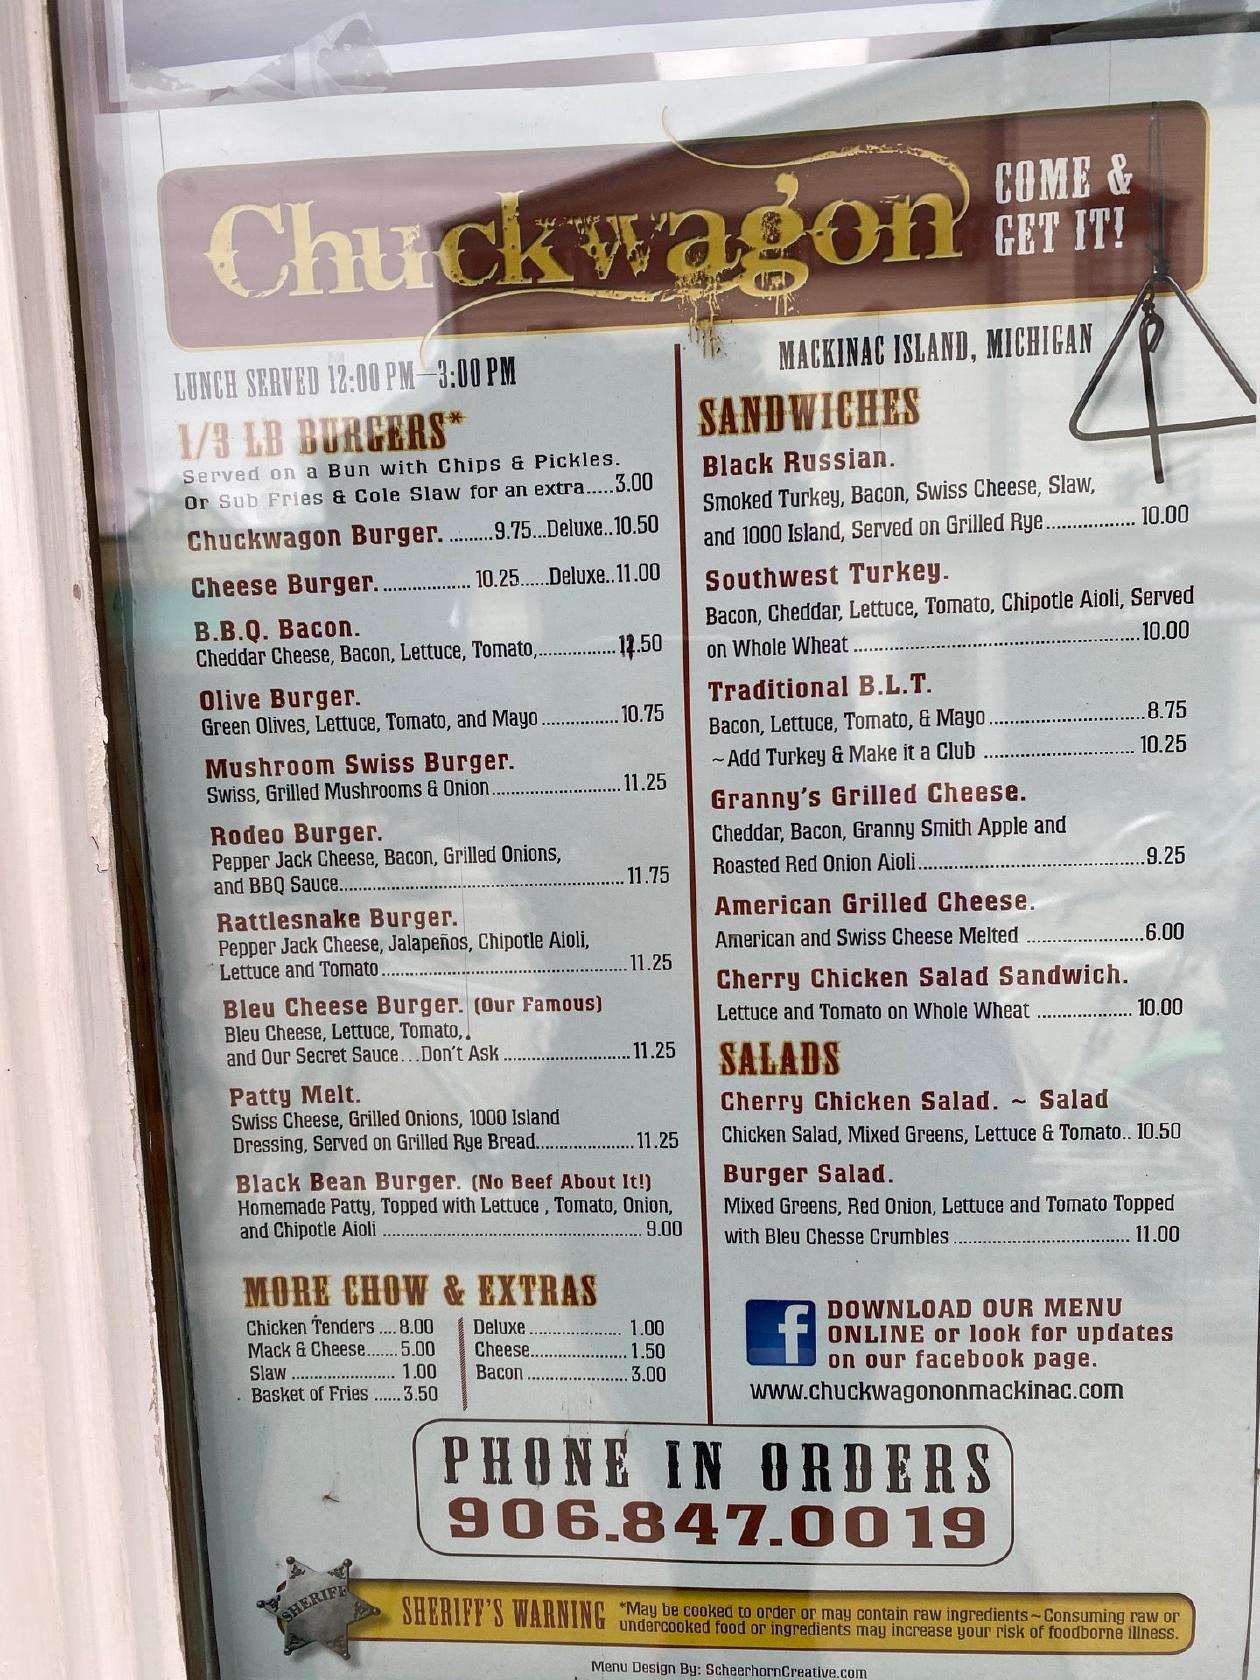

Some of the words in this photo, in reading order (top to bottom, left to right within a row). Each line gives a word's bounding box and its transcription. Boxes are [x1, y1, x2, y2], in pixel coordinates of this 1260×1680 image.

[995, 156, 1090, 204] COME
[1107, 153, 1133, 195] &
[204, 168, 967, 304] Chuckwagon
[995, 211, 1060, 256] GET
[1074, 206, 1125, 249] IT!
[779, 335, 884, 370] MACKINAC
[894, 331, 976, 364] ISLAND,
[986, 323, 1093, 359] MICHIGAN
[174, 370, 238, 401] LUNCH
[246, 366, 319, 398] SERVED
[328, 363, 380, 394] 12:00
[698, 387, 920, 437] SANDWICHES
[178, 421, 230, 461] 1/3
[244, 420, 283, 458] LB
[183, 466, 259, 484] Served
[270, 468, 296, 481] on
[307, 467, 318, 479] a
[328, 463, 370, 478] Bun
[380, 459, 427, 476] with
[438, 457, 500, 474] Chips
[511, 455, 524, 470] &
[535, 452, 620, 469] Pickles.
[703, 452, 773, 477] Black
[784, 451, 895, 473] Russian.
[703, 490, 772, 512] Smoked
[778, 487, 844, 508] Turkey,
[851, 485, 909, 504] Bacon,
[916, 481, 968, 501] Swiss
[974, 478, 1041, 498] Cheese,
[1049, 474, 1095, 495] Slaw,
[706, 565, 839, 592] Southwest
[849, 560, 949, 584] Turkey.
[194, 619, 268, 644] B.B.Q.
[278, 619, 360, 639] Bacon.
[199, 690, 260, 711] Olive
[269, 688, 360, 711] Burger.
[832, 783, 917, 806] Grilled
[928, 782, 1026, 803] Cheese.
[210, 825, 284, 846] Rodeo
[294, 823, 382, 845] Burger.
[216, 909, 360, 933] Rattlesnake
[369, 908, 457, 930] Burger.
[717, 969, 800, 991] Cherry
[811, 968, 908, 988] Chicken
[920, 966, 988, 987] Salad
[999, 964, 1128, 986] Sandwich.
[717, 1004, 778, 1021] Lettuce
[784, 1003, 814, 1020] and
[819, 1003, 882, 1020] Tomato
[888, 1005, 908, 1020] on
[913, 1002, 968, 1020] Whole
[973, 1001, 1030, 1019] Wheat
[1138, 998, 1183, 1016] 10.00
[720, 1041, 840, 1076] SALADS
[232, 1113, 278, 1131] Swiss
[283, 1112, 343, 1130] Cheese,
[349, 1110, 400, 1127] Grilled
[405, 1110, 463, 1129] Onions,
[470, 1109, 507, 1126] 1000
[512, 1109, 560, 1125] Island
[236, 1173, 301, 1194] Black
[310, 1172, 367, 1191] Bean
[375, 1172, 461, 1193] Burger.
[472, 1174, 504, 1192] (No
[511, 1174, 553, 1190] Beef
[560, 1174, 616, 1189] About
[623, 1173, 651, 1192] It!)
[723, 1164, 808, 1186] Burger
[818, 1164, 893, 1183] Salad.
[724, 1197, 774, 1214] Mixed
[780, 1197, 842, 1216] Greens,
[848, 1197, 880, 1215] Red
[885, 1197, 936, 1216] Onion,
[942, 1197, 1004, 1214] Lettuce
[1010, 1195, 1040, 1213] and
[1046, 1195, 1107, 1212] Tomato
[1113, 1194, 1175, 1214] Topped
[242, 1275, 329, 1308] MORE
[344, 1274, 429, 1306] CHOW
[443, 1274, 465, 1306] &
[478, 1274, 597, 1306] EXTRAS
[827, 1299, 971, 1319] DOWNLOAD
[983, 1298, 1033, 1318] OUR
[1044, 1298, 1122, 1317] MENU
[246, 1319, 307, 1336] Chicken
[311, 1319, 374, 1334] Tenders
[400, 1318, 433, 1334] 8.00
[473, 1319, 525, 1335] Deluxe
[631, 1319, 664, 1336] 1.00
[828, 1325, 924, 1344] ONLINE
[935, 1328, 960, 1343] or
[969, 1324, 1020, 1343] look
[1031, 1323, 1067, 1342] for
[1077, 1323, 1173, 1345] updates
[248, 1342, 291, 1359] Mack
[296, 1341, 306, 1357] &
[401, 1341, 435, 1357] 5.00
[632, 1342, 665, 1359] 1.50
[829, 1354, 855, 1369] on
[866, 1354, 906, 1369] our
[916, 1348, 1024, 1369] facebook
[1034, 1352, 1097, 1370] page.
[250, 1365, 286, 1381] Slaw
[403, 1363, 437, 1379] 1.00
[476, 1364, 523, 1380] Bacon
[632, 1366, 666, 1382] 3.00
[251, 1386, 305, 1404] Basket
[310, 1386, 324, 1401] of
[329, 1385, 368, 1401] Fries
[404, 1385, 438, 1402] 3.50
[750, 1380, 1124, 1404] www.chuckwagononmackinac.com
[442, 1436, 629, 1488] PHONE
[666, 1439, 721, 1490] IN
[761, 1442, 991, 1494] ORDERS
[450, 1497, 986, 1549] 906.847.0019
[281, 1585, 347, 1622] SHERIFF
[512, 1598, 606, 1631] WARNING
[662, 1602, 678, 1616] be
[684, 1603, 733, 1618] cooked
[739, 1605, 751, 1618] to
[757, 1605, 795, 1619] order
[801, 1608, 816, 1619] or
[822, 1607, 850, 1621] may
[857, 1607, 908, 1621] contain
[914, 1608, 941, 1620] raw
[1130, 1610, 1158, 1623] raw
[1164, 1610, 1180, 1623] or
[619, 1618, 710, 1634] undercooked
[715, 1621, 746, 1635] food
[751, 1623, 766, 1635] or
[771, 1621, 851, 1637] ingredients
[857, 1624, 886, 1638] may
[892, 1625, 952, 1638] increase
[957, 1626, 991, 1640] your
[996, 1625, 1025, 1638] risk
[1030, 1625, 1044, 1638] of
[1049, 1625, 1123, 1640] foodborne
[1128, 1625, 1179, 1640] illness.
[591, 1661, 628, 1673] Menu
[632, 1661, 676, 1675] Design
[680, 1662, 701, 1676] By:
[706, 1663, 867, 1679] ScheerhornCreative.com
